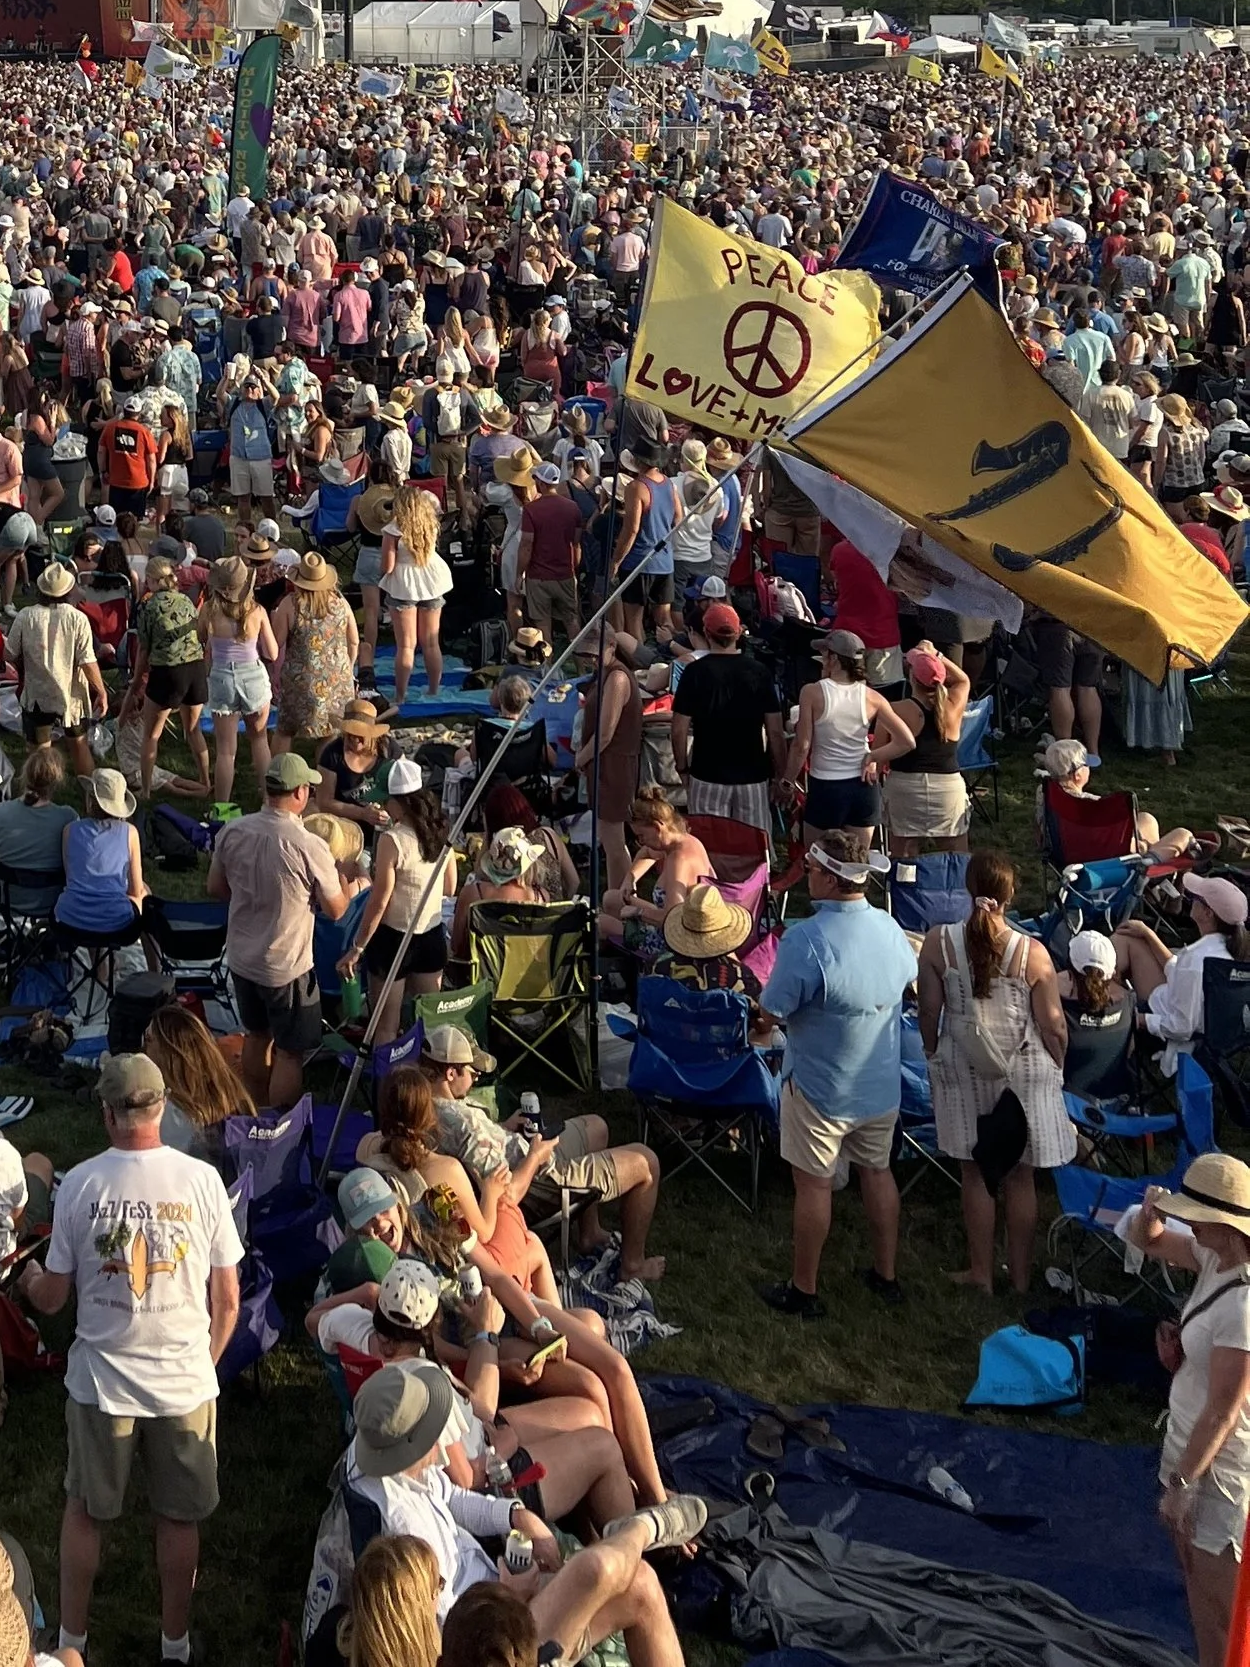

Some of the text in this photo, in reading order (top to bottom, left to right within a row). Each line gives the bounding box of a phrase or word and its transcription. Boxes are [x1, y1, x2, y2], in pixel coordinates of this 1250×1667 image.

[784, 4, 811, 32] 3
[234, 149, 248, 192] NOR
[720, 248, 839, 316] PEACE
[912, 283, 932, 297] 202
[437, 994, 476, 1011] Academy
[390, 1037, 416, 1059] Academy
[156, 1201, 192, 1222] 2024
